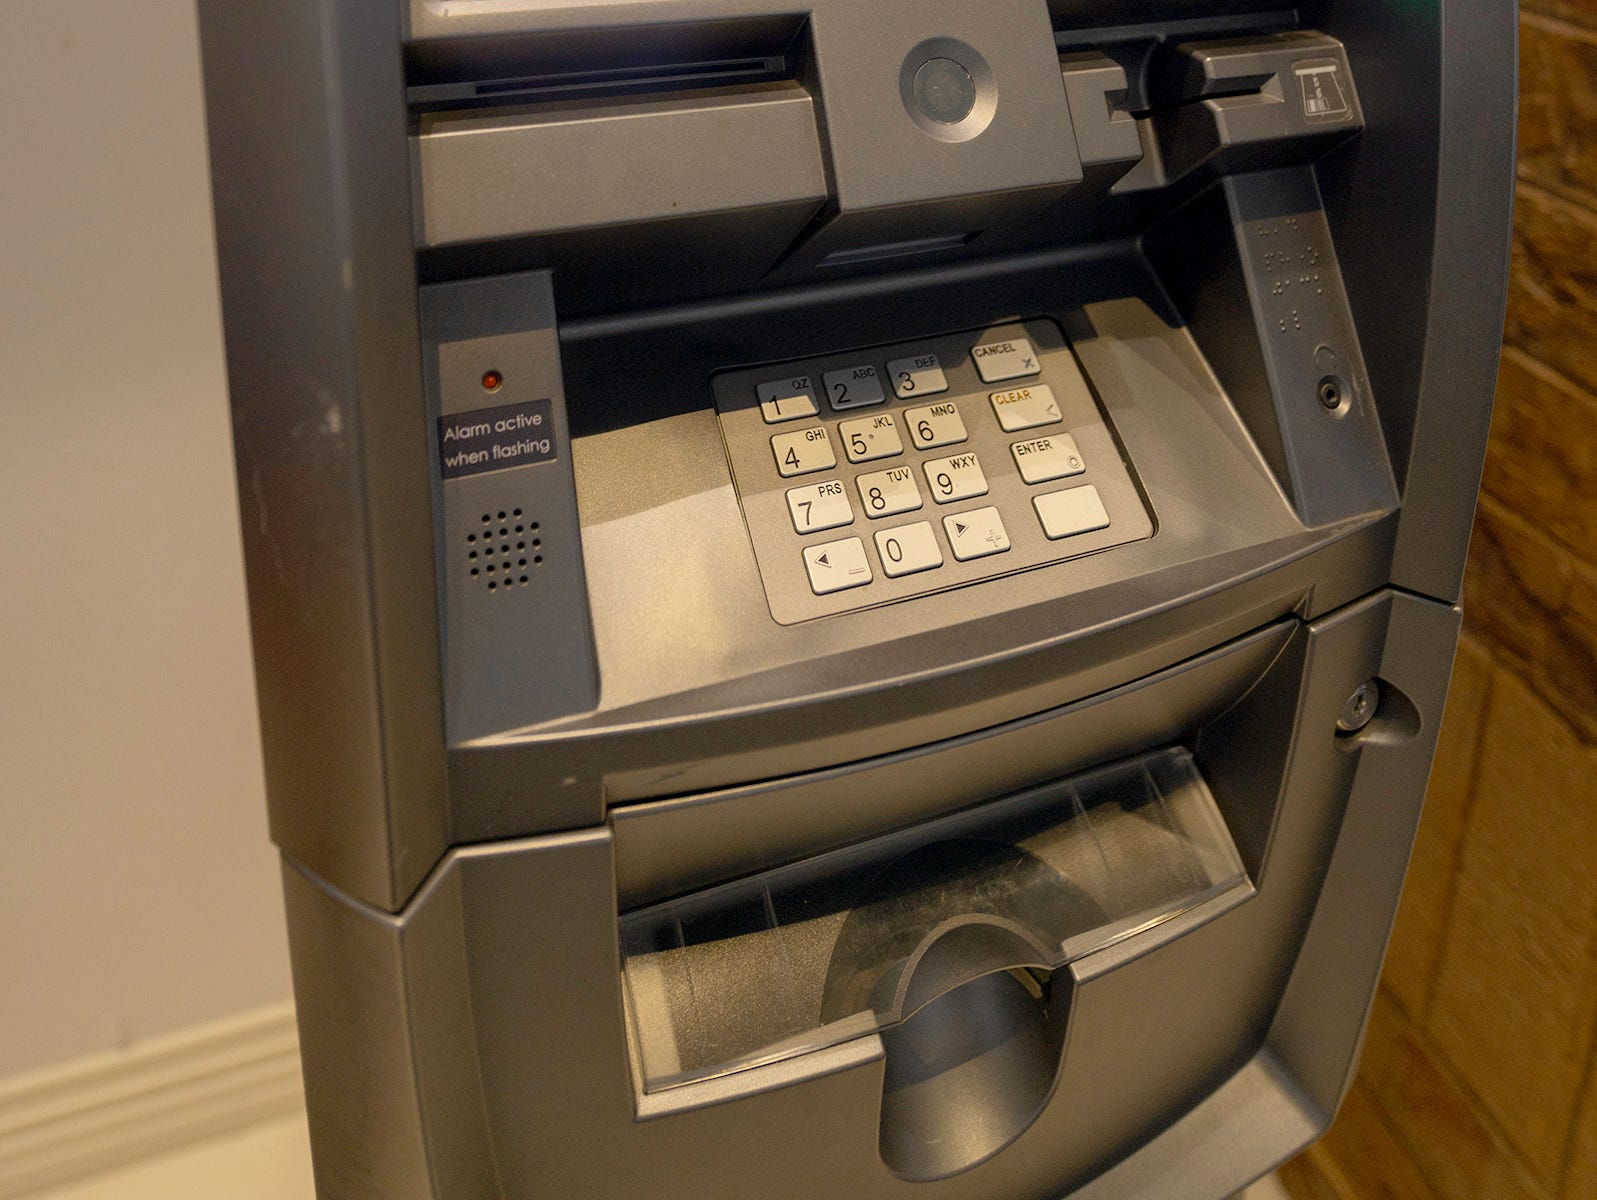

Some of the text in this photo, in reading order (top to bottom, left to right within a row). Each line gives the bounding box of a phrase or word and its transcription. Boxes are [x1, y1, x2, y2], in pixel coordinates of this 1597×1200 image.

[974, 343, 1016, 357] CANCEL
[915, 357, 936, 368] DEF
[852, 367, 876, 380] ABC
[898, 371, 915, 391] 3
[791, 378, 809, 390] QZ
[833, 383, 850, 403] 2
[768, 395, 782, 416] 1
[995, 390, 1031, 404] CLEAR
[930, 404, 956, 418] MNO
[443, 413, 542, 441] Alarm active
[873, 417, 893, 429] JKL
[917, 420, 934, 441] 6
[805, 430, 826, 442] GHI
[851, 433, 867, 454] 5
[444, 439, 550, 467] when flashing
[1016, 440, 1053, 455] ENTER
[784, 447, 800, 469] 4
[949, 455, 976, 470] WXY
[886, 468, 910, 483] TUV
[937, 472, 954, 495] 9
[818, 482, 843, 498] PRS
[868, 487, 886, 510] 8
[797, 500, 813, 526] 7
[886, 538, 903, 562] 0
